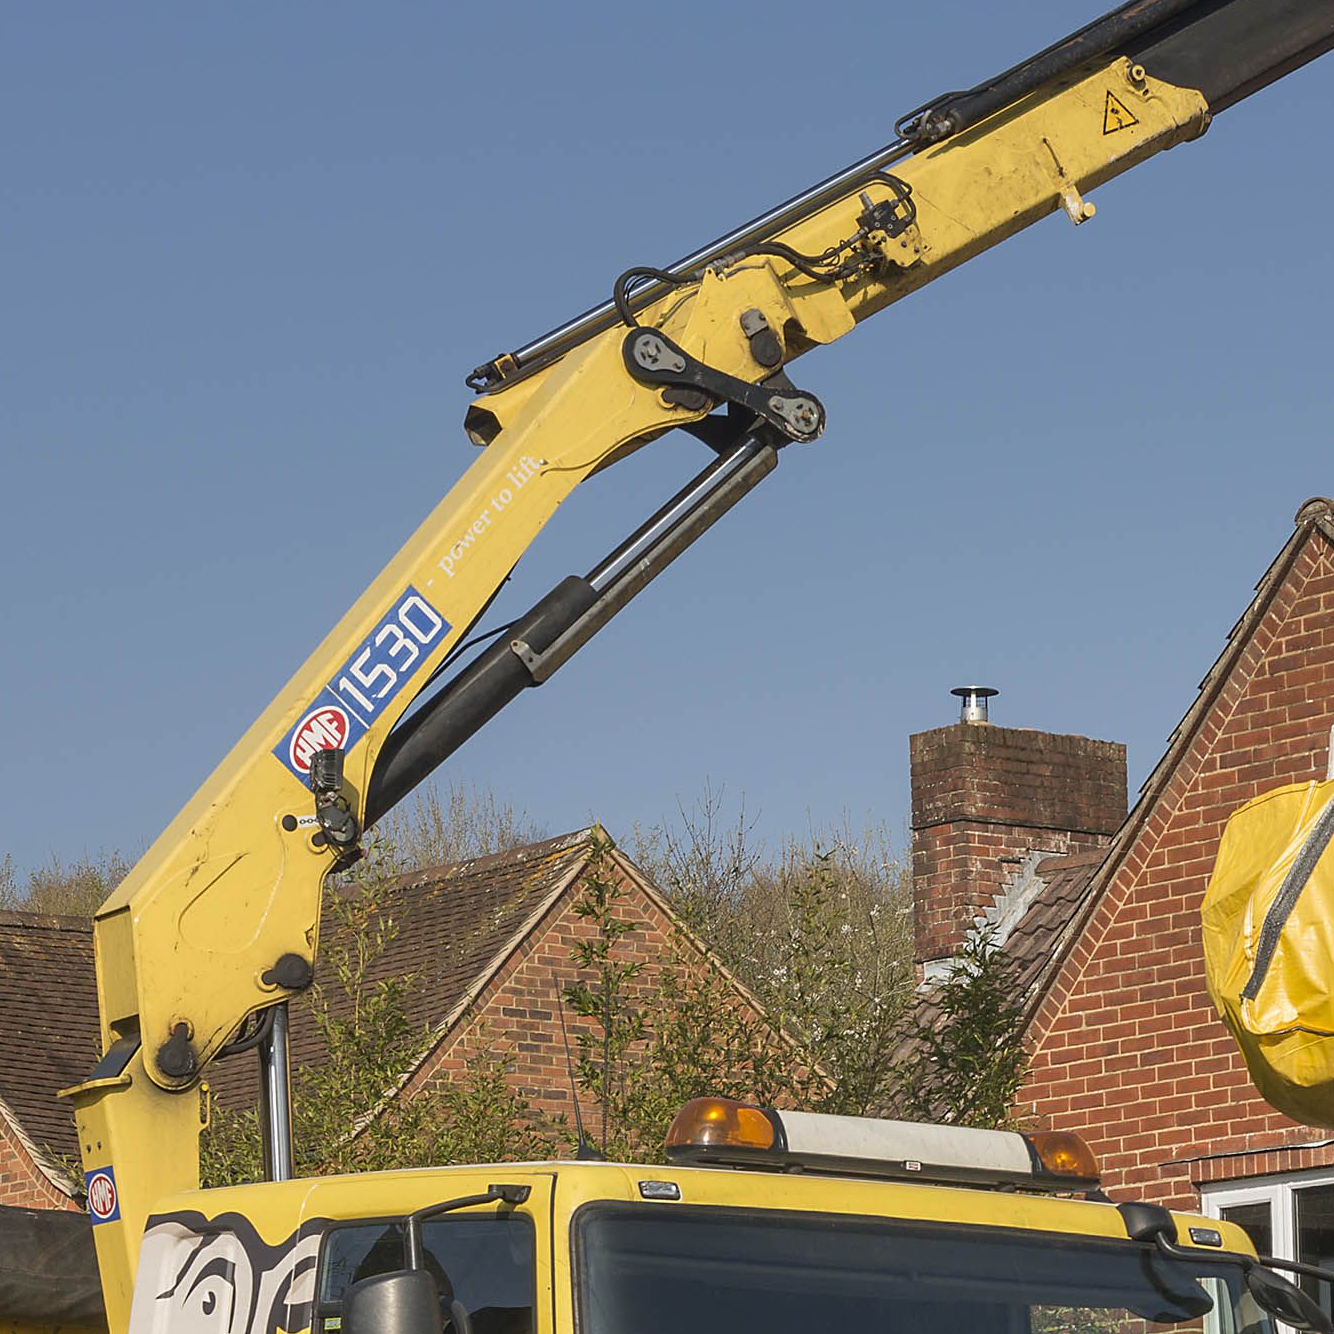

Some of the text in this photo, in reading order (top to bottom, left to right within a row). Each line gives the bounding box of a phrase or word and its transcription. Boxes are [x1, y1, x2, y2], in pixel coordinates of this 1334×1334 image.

[438, 509, 492, 579] power
[490, 488, 513, 512] to
[295, 596, 443, 768] HMF 1530
[91, 1179, 112, 1213] HMF
